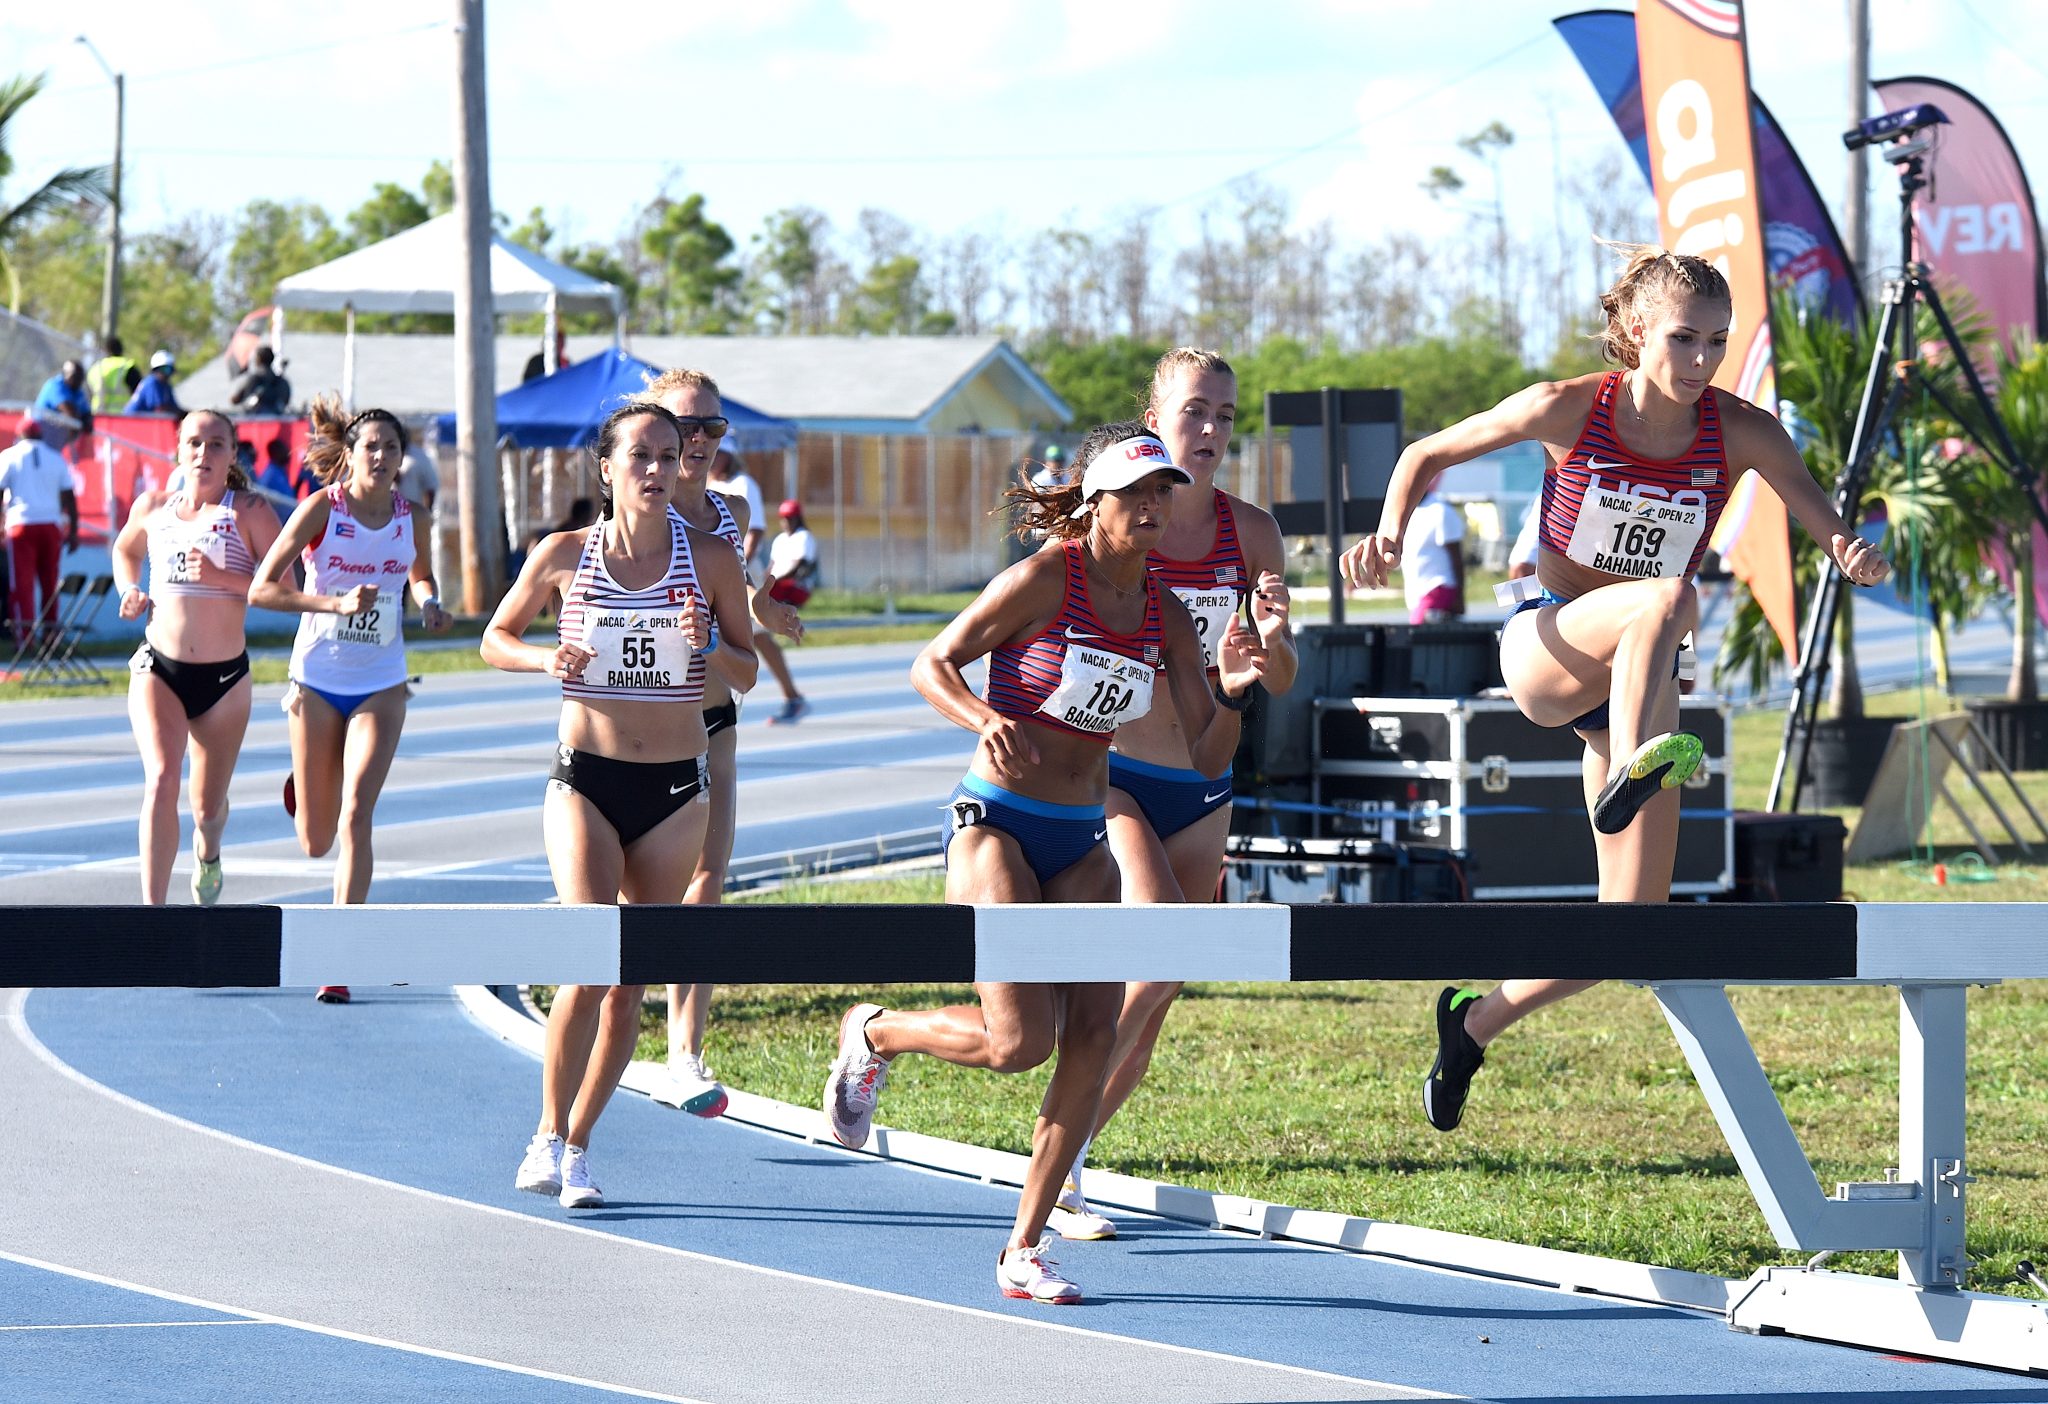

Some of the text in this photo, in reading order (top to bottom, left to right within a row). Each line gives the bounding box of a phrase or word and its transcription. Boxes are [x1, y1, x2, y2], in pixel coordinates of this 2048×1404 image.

[1656, 79, 1746, 334] ali
[1125, 444, 1165, 461] USA
[1599, 495, 1696, 525] NACAC OPEN 22
[1612, 521, 1666, 558] 169
[327, 555, 376, 575] Puerto
[1592, 552, 1663, 578] BAHAMAS
[1195, 595, 1229, 608] OPEN 22
[348, 609, 380, 632] 132
[596, 616, 625, 628] NACAC
[650, 617, 672, 628] OPEN
[336, 628, 382, 646] BAHAMAS
[622, 637, 656, 669] 55
[607, 670, 671, 687] BAHAMAS
[1080, 652, 1150, 684] NACAC OPEN 22
[1085, 680, 1134, 716] 164
